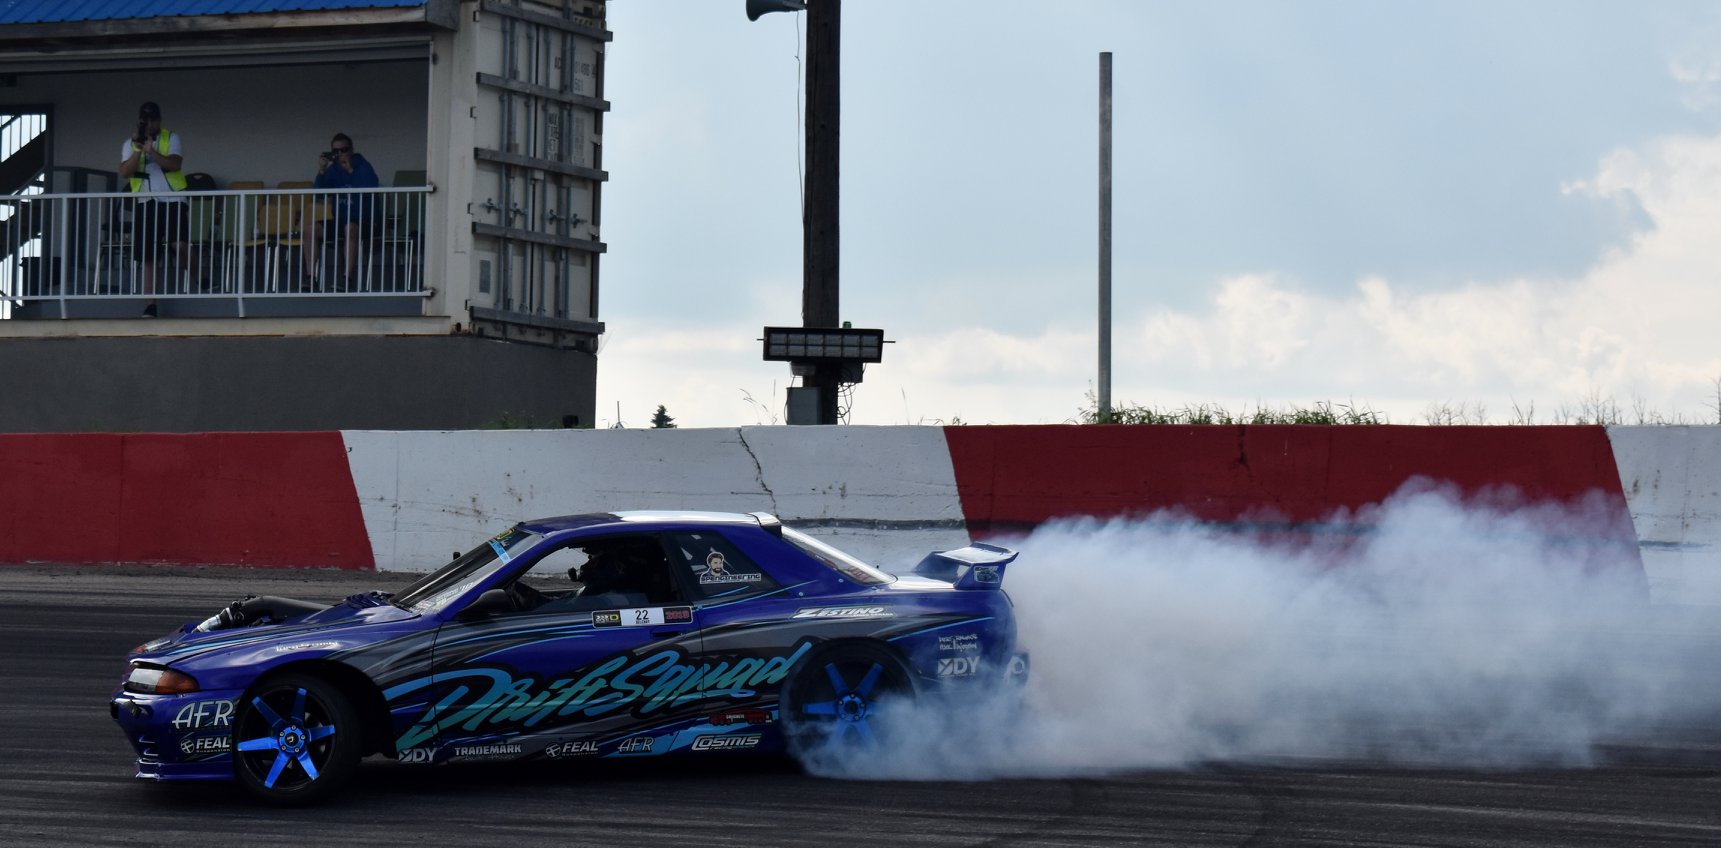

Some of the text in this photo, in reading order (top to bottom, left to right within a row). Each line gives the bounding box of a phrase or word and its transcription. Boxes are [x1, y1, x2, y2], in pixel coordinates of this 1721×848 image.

[635, 610, 649, 620] 22
[792, 606, 884, 619] ZESTINO
[172, 700, 234, 729] AFR
[196, 736, 230, 749] FEAL
[562, 740, 599, 753] FEAL
[618, 737, 655, 752] AFR
[454, 744, 522, 756] TRADEMARK
